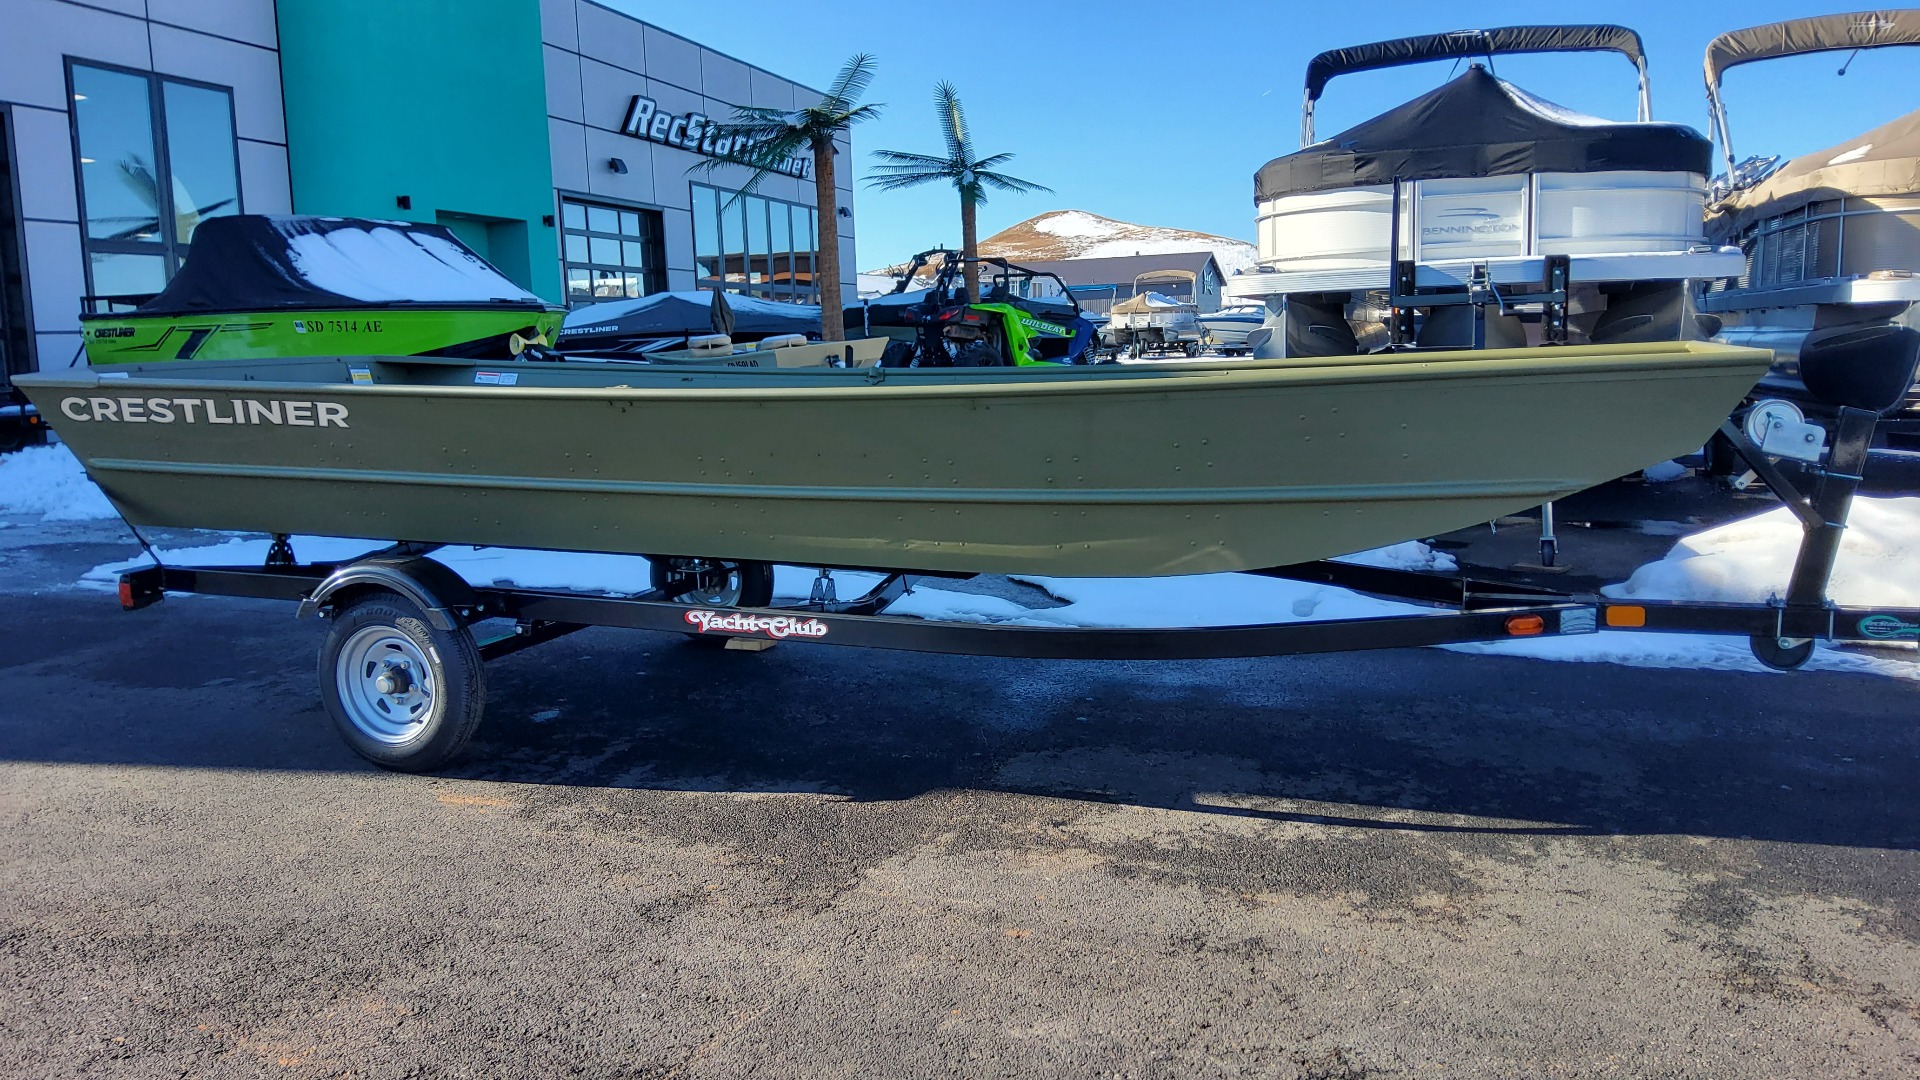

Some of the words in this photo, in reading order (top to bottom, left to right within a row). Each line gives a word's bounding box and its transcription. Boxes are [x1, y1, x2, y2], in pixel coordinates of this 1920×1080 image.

[620, 94, 812, 178] RecSta.net
[1421, 223, 1519, 236] BENNINGTON
[307, 321, 324, 333] SD
[328, 321, 357, 333] 7514
[363, 321, 383, 333] AE
[1021, 318, 1064, 334] WILDCAT
[60, 396, 350, 428] CRESTLINER
